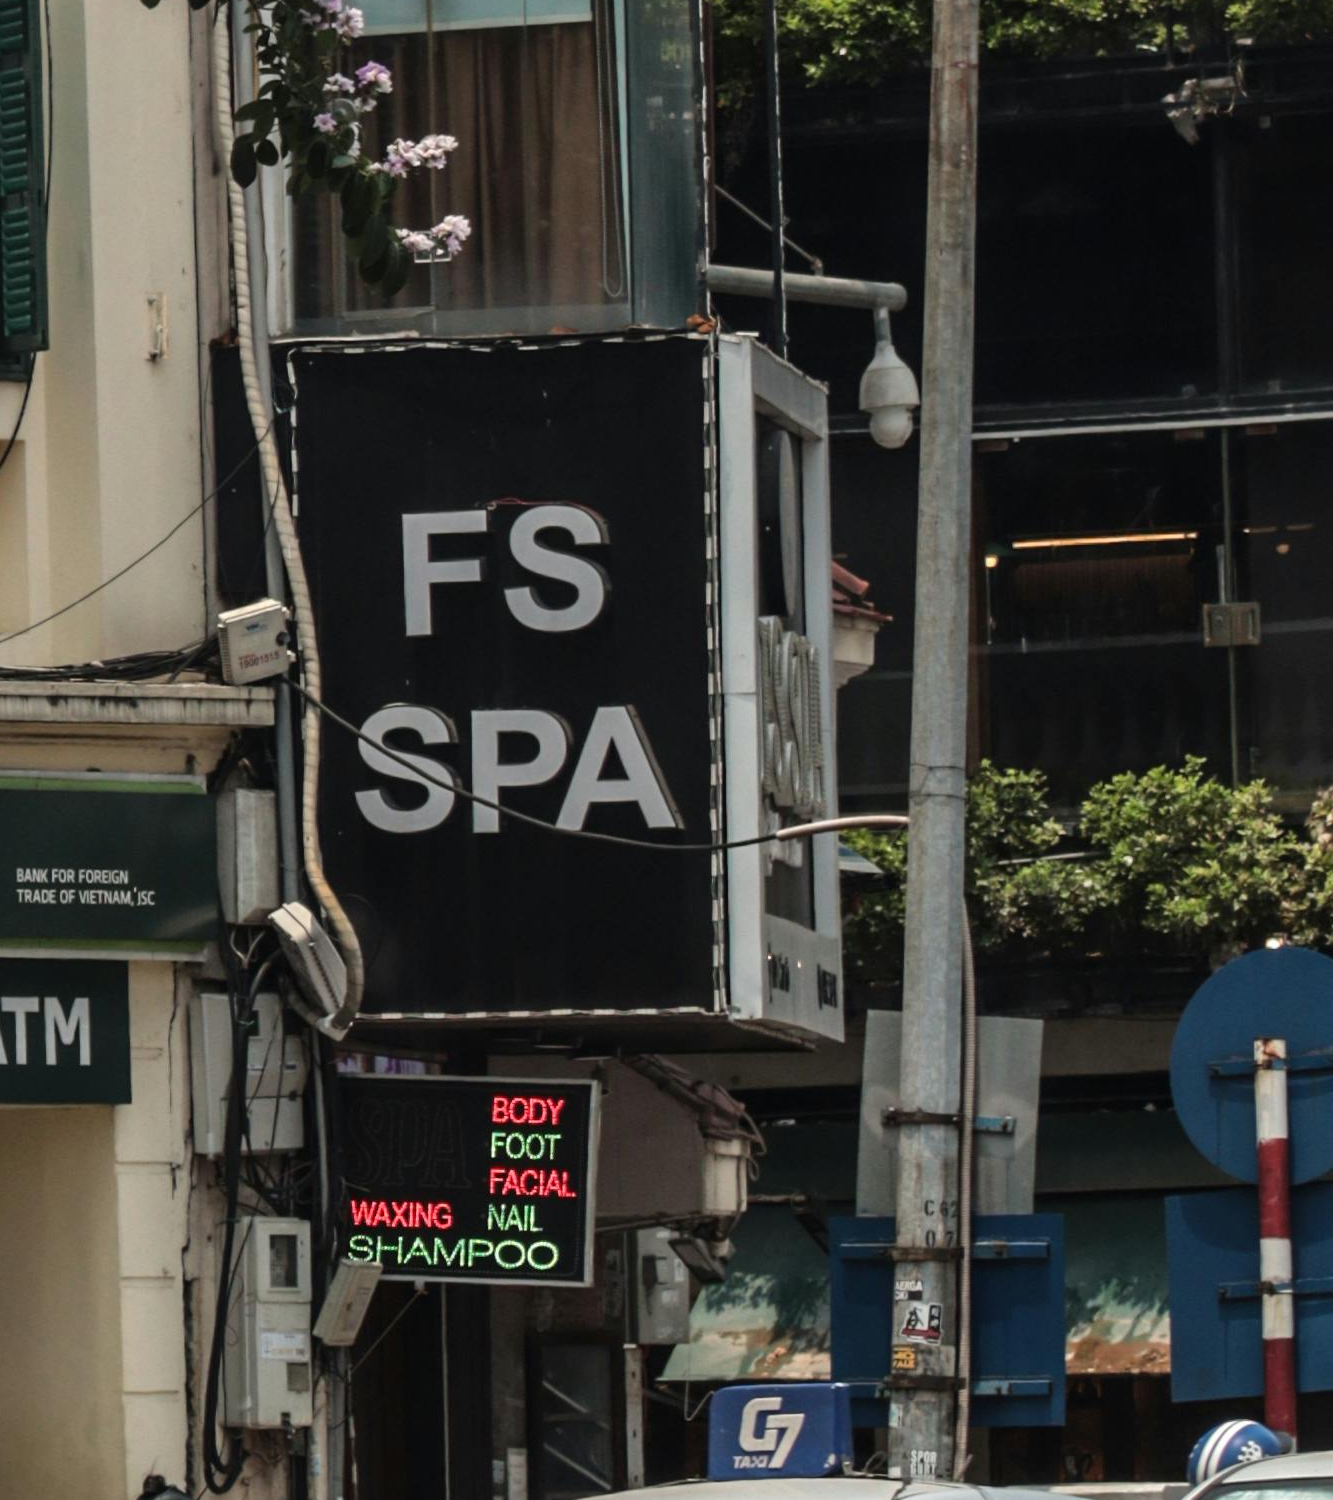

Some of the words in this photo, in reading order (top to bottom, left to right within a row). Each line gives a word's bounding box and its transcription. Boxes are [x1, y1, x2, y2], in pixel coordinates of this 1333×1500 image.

[401, 504, 612, 637] FS
[355, 702, 686, 834] SPA
[16, 868, 48, 883] BANK
[51, 868, 75, 883] FOR
[78, 869, 129, 884] FOREIGN
[16, 889, 56, 904] TRADE
[60, 890, 76, 904] OF
[136, 891, 155, 906] JSC
[490, 1095, 566, 1126] BODY
[489, 1131, 562, 1161] FOOT
[488, 1167, 577, 1198] FACIAL
[350, 1199, 454, 1230] WAXING
[487, 1202, 543, 1232] NAIL
[347, 1234, 560, 1271] SHAMPOO
[739, 1396, 806, 1469] G7
[732, 1455, 770, 1469] TAXI
